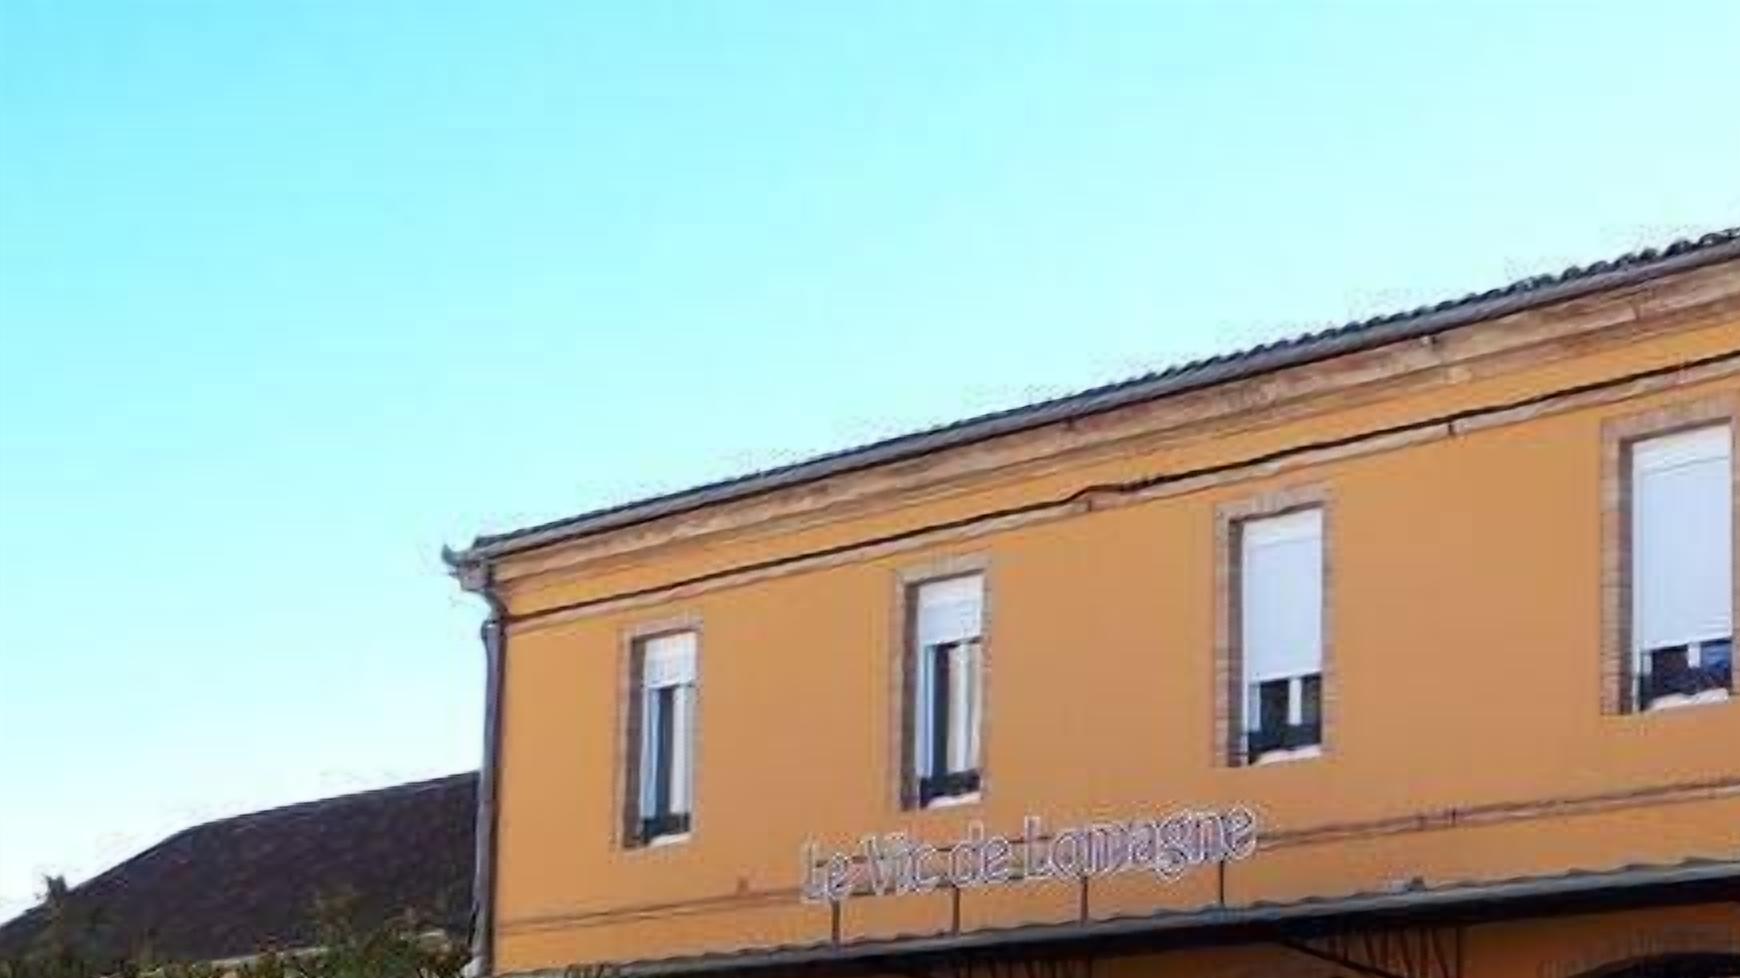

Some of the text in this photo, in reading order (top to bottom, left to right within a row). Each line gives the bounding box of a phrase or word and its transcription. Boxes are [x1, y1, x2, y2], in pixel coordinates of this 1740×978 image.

[803, 806, 1257, 901] Le Vic de Lomagne
